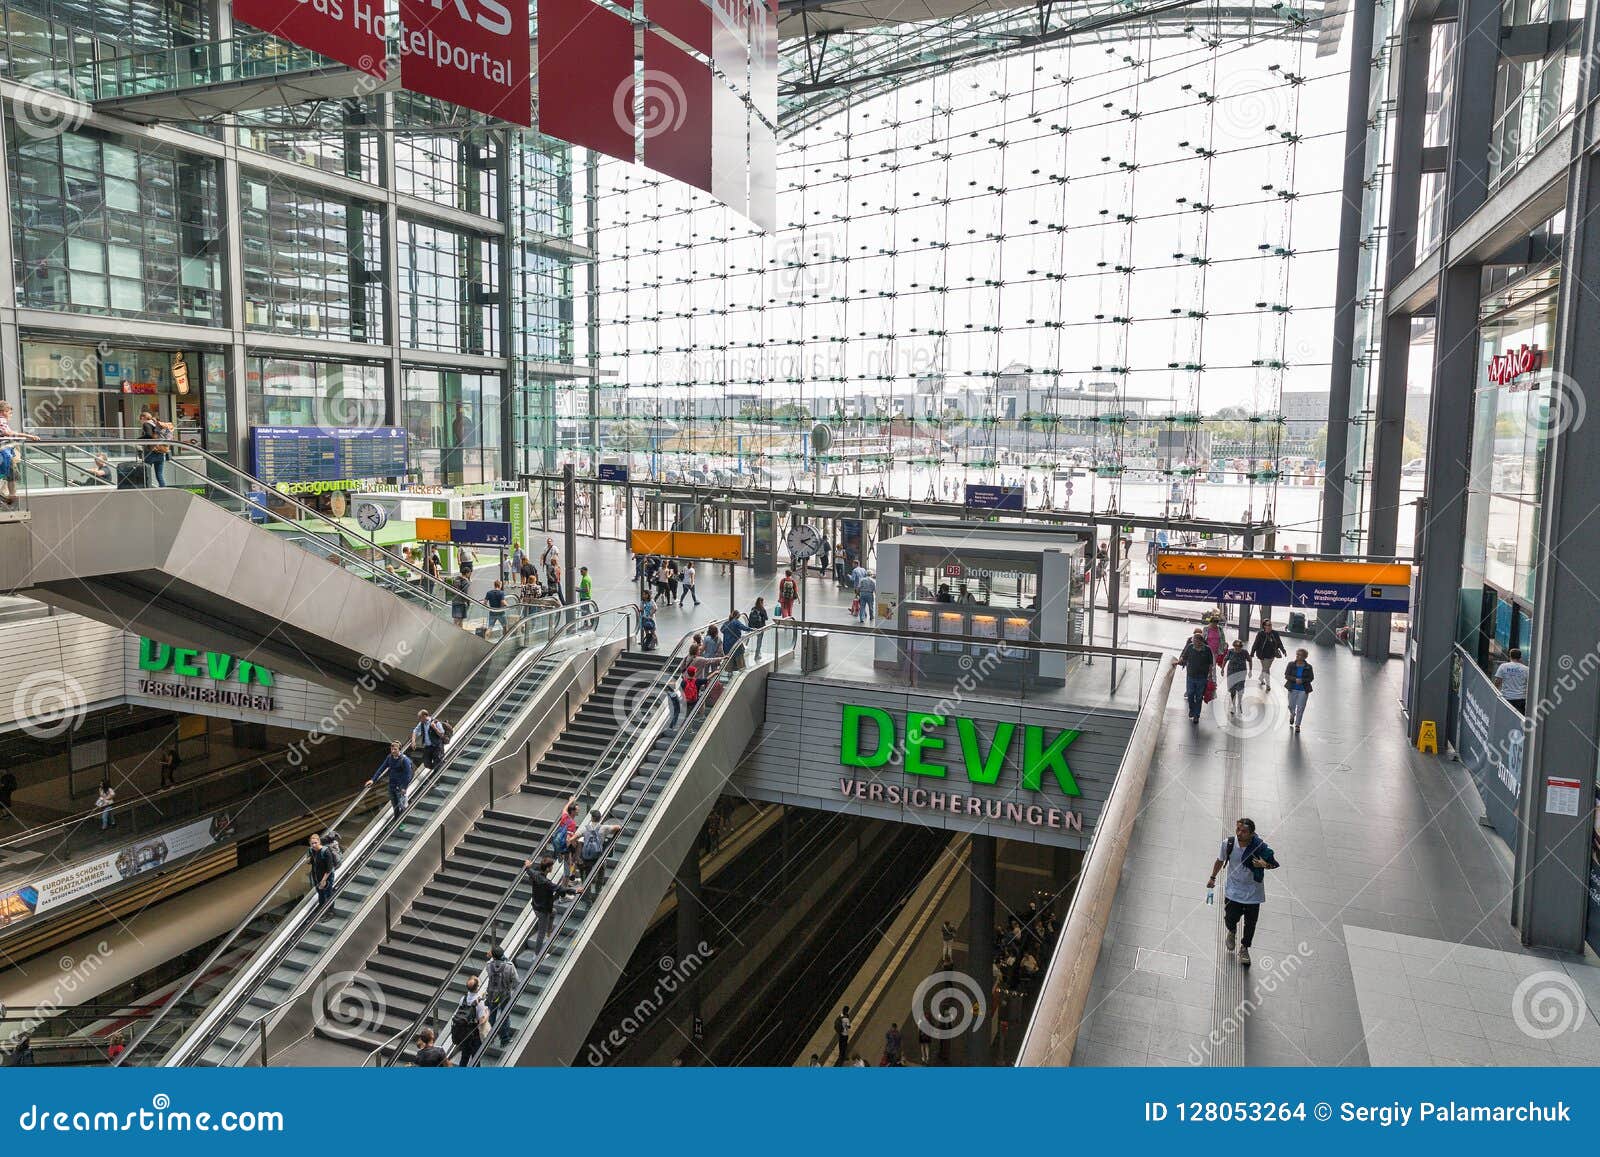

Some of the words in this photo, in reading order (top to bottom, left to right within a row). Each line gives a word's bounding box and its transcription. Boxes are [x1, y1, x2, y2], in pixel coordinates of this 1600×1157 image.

[297, 0, 344, 21] as
[353, 0, 512, 87] Hotelportal
[1487, 346, 1535, 385] VAPIANO
[407, 484, 443, 495] TICKETS
[946, 564, 961, 577] DB
[967, 566, 1029, 581] Information
[1313, 595, 1358, 604] Washingtonplatz
[1314, 588, 1338, 597] Ausgang
[138, 679, 274, 712] VERSICHERUNGEN
[839, 703, 1083, 798] DEVK
[838, 777, 1085, 833] VERSICHERUNGEN
[42, 875, 75, 892] EUROPAS
[49, 870, 105, 896] SCHATZKAMMER
